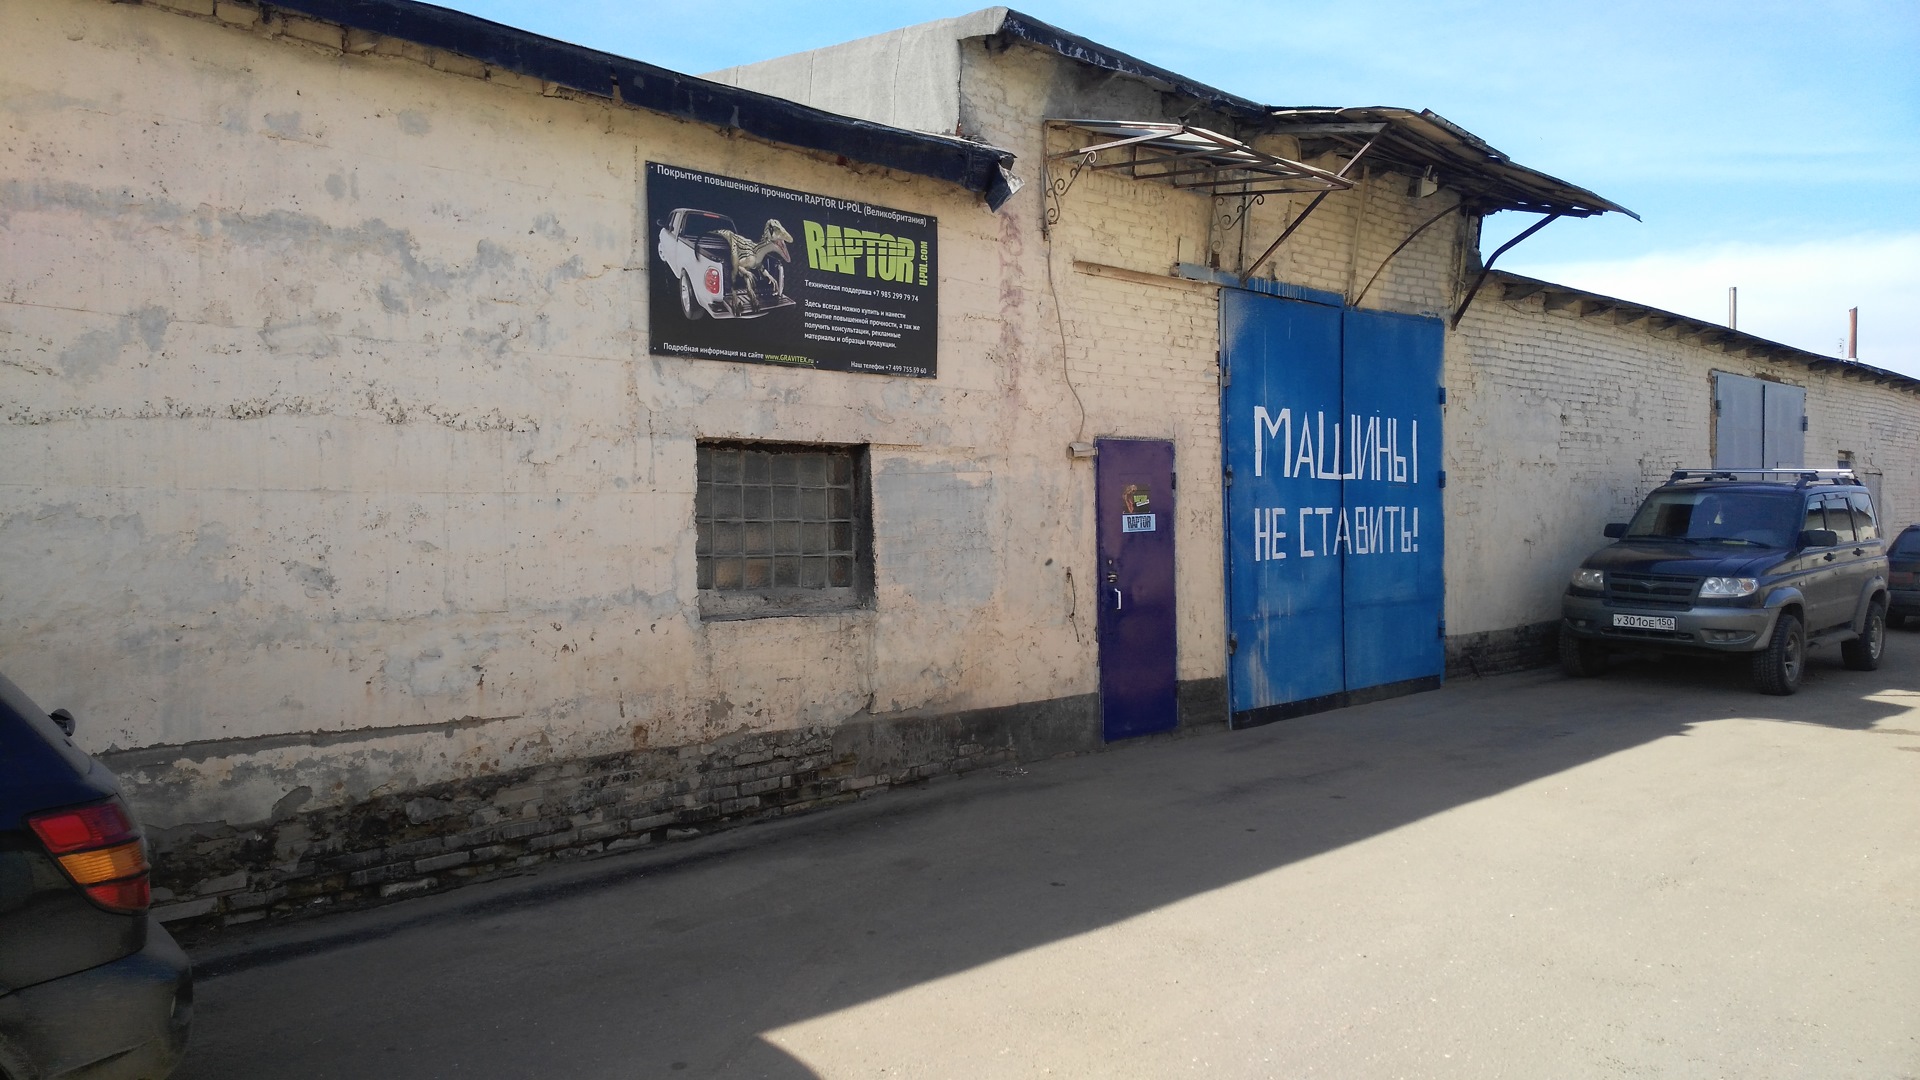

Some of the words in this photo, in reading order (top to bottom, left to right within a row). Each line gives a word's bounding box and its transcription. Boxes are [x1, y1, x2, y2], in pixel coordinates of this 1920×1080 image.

[657, 164, 703, 183] Покрытие
[704, 176, 760, 194] повышенной
[761, 187, 803, 203] прочности
[804, 194, 837, 209] RAPTOR
[838, 200, 863, 214] U-POL
[863, 205, 927, 227] (Великобритания)
[803, 219, 916, 284] RAPTOR
[804, 279, 841, 292] Техническая
[841, 286, 872, 296] поддержка
[872, 289, 880, 297] +7
[880, 290, 892, 299] 985
[892, 292, 903, 300] 299
[903, 293, 911, 301] 79
[804, 299, 822, 309] Здесь
[822, 303, 841, 312] всегда
[841, 306, 861, 314] можно
[861, 308, 880, 316] купить
[804, 311, 832, 320] покрытие
[832, 315, 869, 325] повышенной
[869, 319, 899, 329] прочности,
[804, 322, 831, 331] получить
[871, 330, 902, 339] рекламные
[804, 333, 836, 342] материалы
[841, 337, 866, 345] образцы
[866, 339, 897, 348] продукции.
[663, 342, 699, 354] Подробная
[699, 347, 739, 358] информация
[747, 352, 764, 360] сайте
[850, 360, 863, 369] Наш
[863, 362, 885, 371] телефон
[892, 364, 903, 372] 499
[902, 365, 913, 373] 755
[913, 366, 920, 374] 59
[1126, 515, 1152, 529] RAPTOR
[1254, 507, 1287, 562] НЕ
[1299, 506, 1419, 558] СТАВИТЬ!
[1656, 618, 1672, 626] 150
